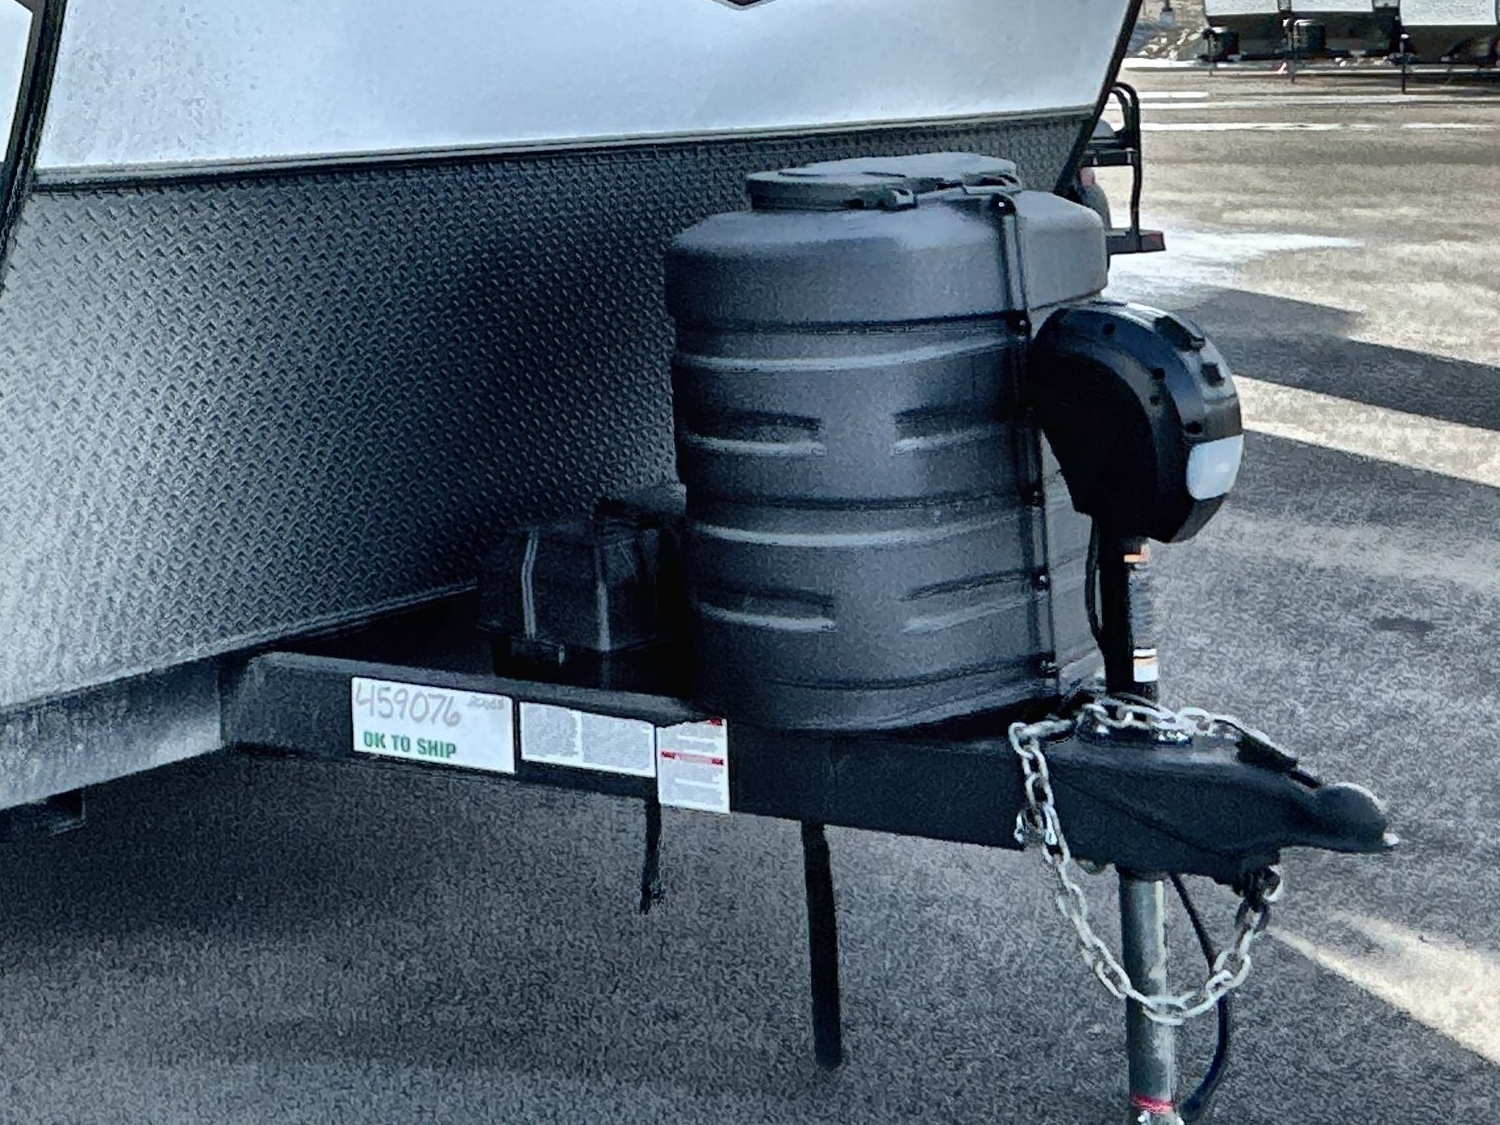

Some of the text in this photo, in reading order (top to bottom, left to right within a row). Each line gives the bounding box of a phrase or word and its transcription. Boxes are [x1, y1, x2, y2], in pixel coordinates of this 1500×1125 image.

[355, 681, 461, 727] 459076
[363, 730, 457, 759] OK TO SHIP
